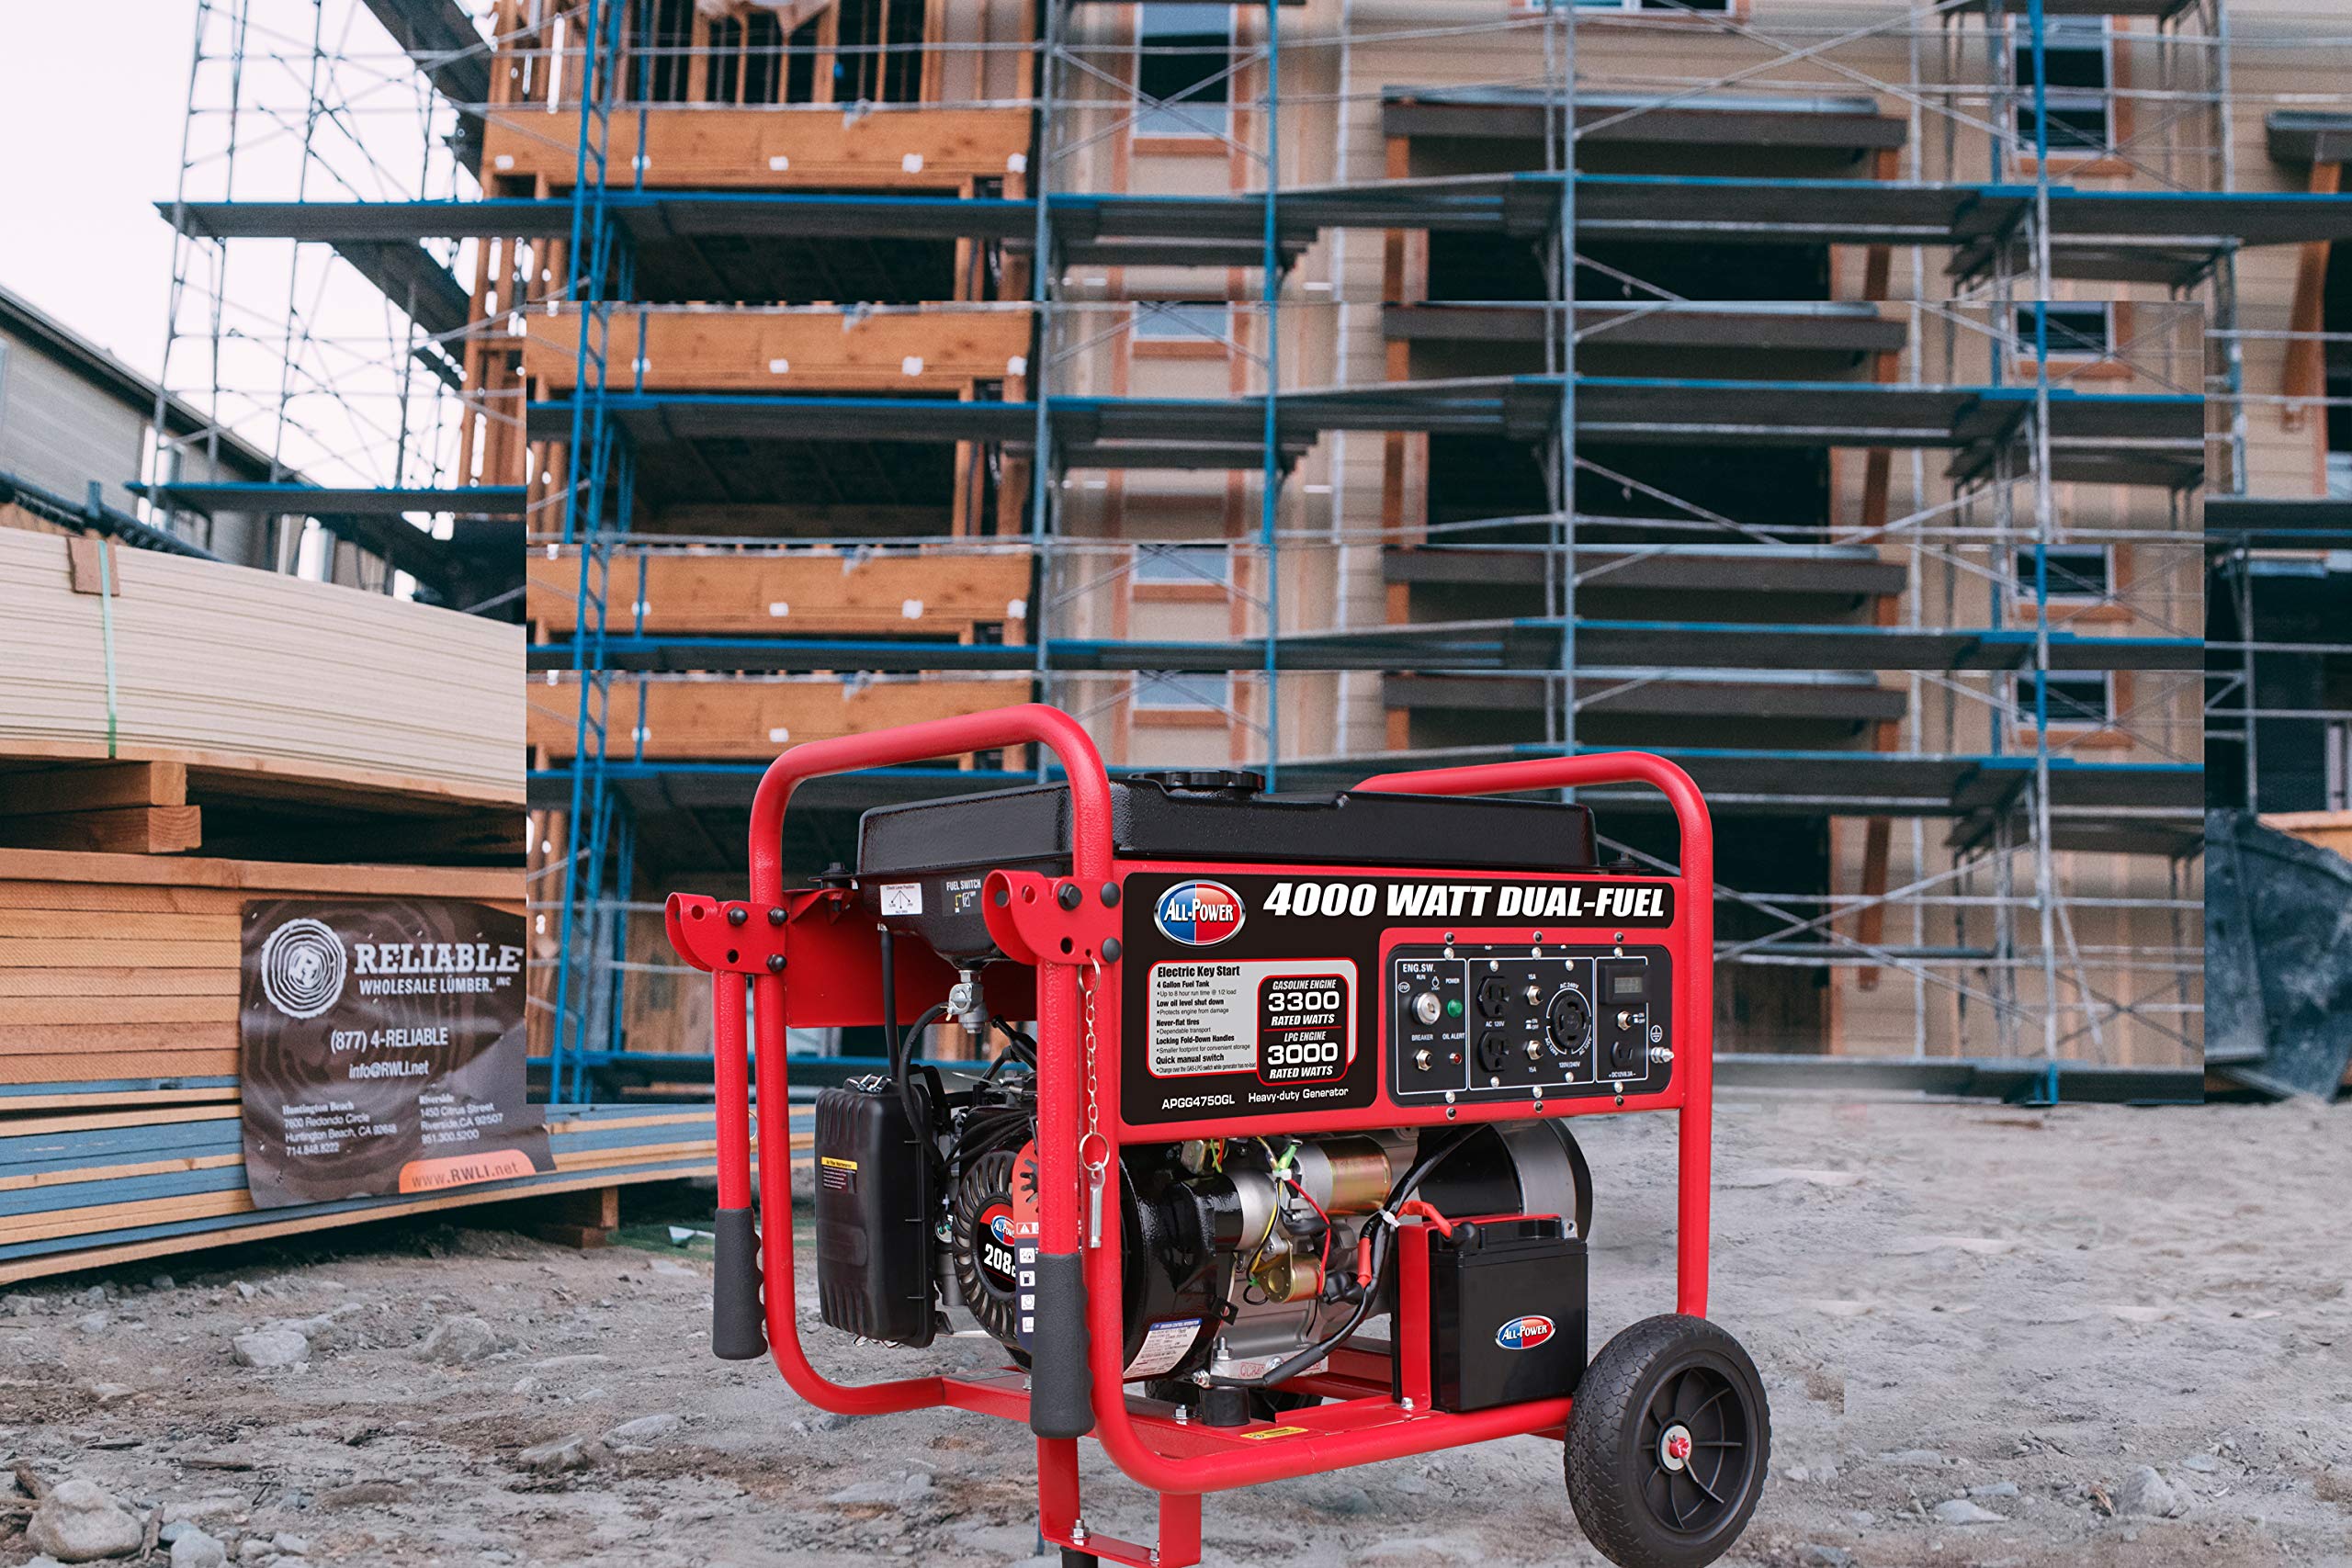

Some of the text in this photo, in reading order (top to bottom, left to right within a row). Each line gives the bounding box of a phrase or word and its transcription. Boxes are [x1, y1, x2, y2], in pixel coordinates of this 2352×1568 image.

[946, 879, 981, 891] FUEL SWITCH
[1262, 883, 1664, 917] 4000 WATT DUAL-FUEL
[1164, 898, 1234, 921] ALL-POWER
[354, 943, 524, 974] RELIABLE
[1158, 965, 1240, 977] Electric Key Start
[359, 978, 436, 996] WHOLESALE
[496, 976, 512, 987] INC
[1272, 979, 1337, 990] GASOLINE ENGINE
[1268, 991, 1340, 1011] 3300
[1157, 1019, 1185, 1027] Never-flat
[1272, 1013, 1335, 1026] RATED WATTS
[331, 1027, 448, 1055] (877) 4-RELIABLE
[1157, 1034, 1235, 1045] Locking Fold-Down Handles
[1283, 1031, 1327, 1043] LPG ENGINE
[1156, 1054, 1225, 1066] Quick manual switch
[1268, 1043, 1339, 1065] 3000
[349, 1060, 429, 1079] info@RWLI.net
[1270, 1066, 1333, 1079] RATED WATTS
[1162, 1094, 1235, 1110] APGG4750GL
[1249, 1088, 1349, 1103] Heavy-duty Generator
[282, 1100, 355, 1115] Huntington Beach
[466, 1102, 494, 1114] Street
[305, 1114, 345, 1127] Redondo
[345, 1112, 370, 1124] Circle
[285, 1131, 327, 1144] Huntington
[357, 1125, 372, 1136] CA
[412, 1161, 519, 1189] www.RWLI.net
[983, 1243, 1016, 1279] 208c
[1501, 1325, 1547, 1340] ALL-POWER
